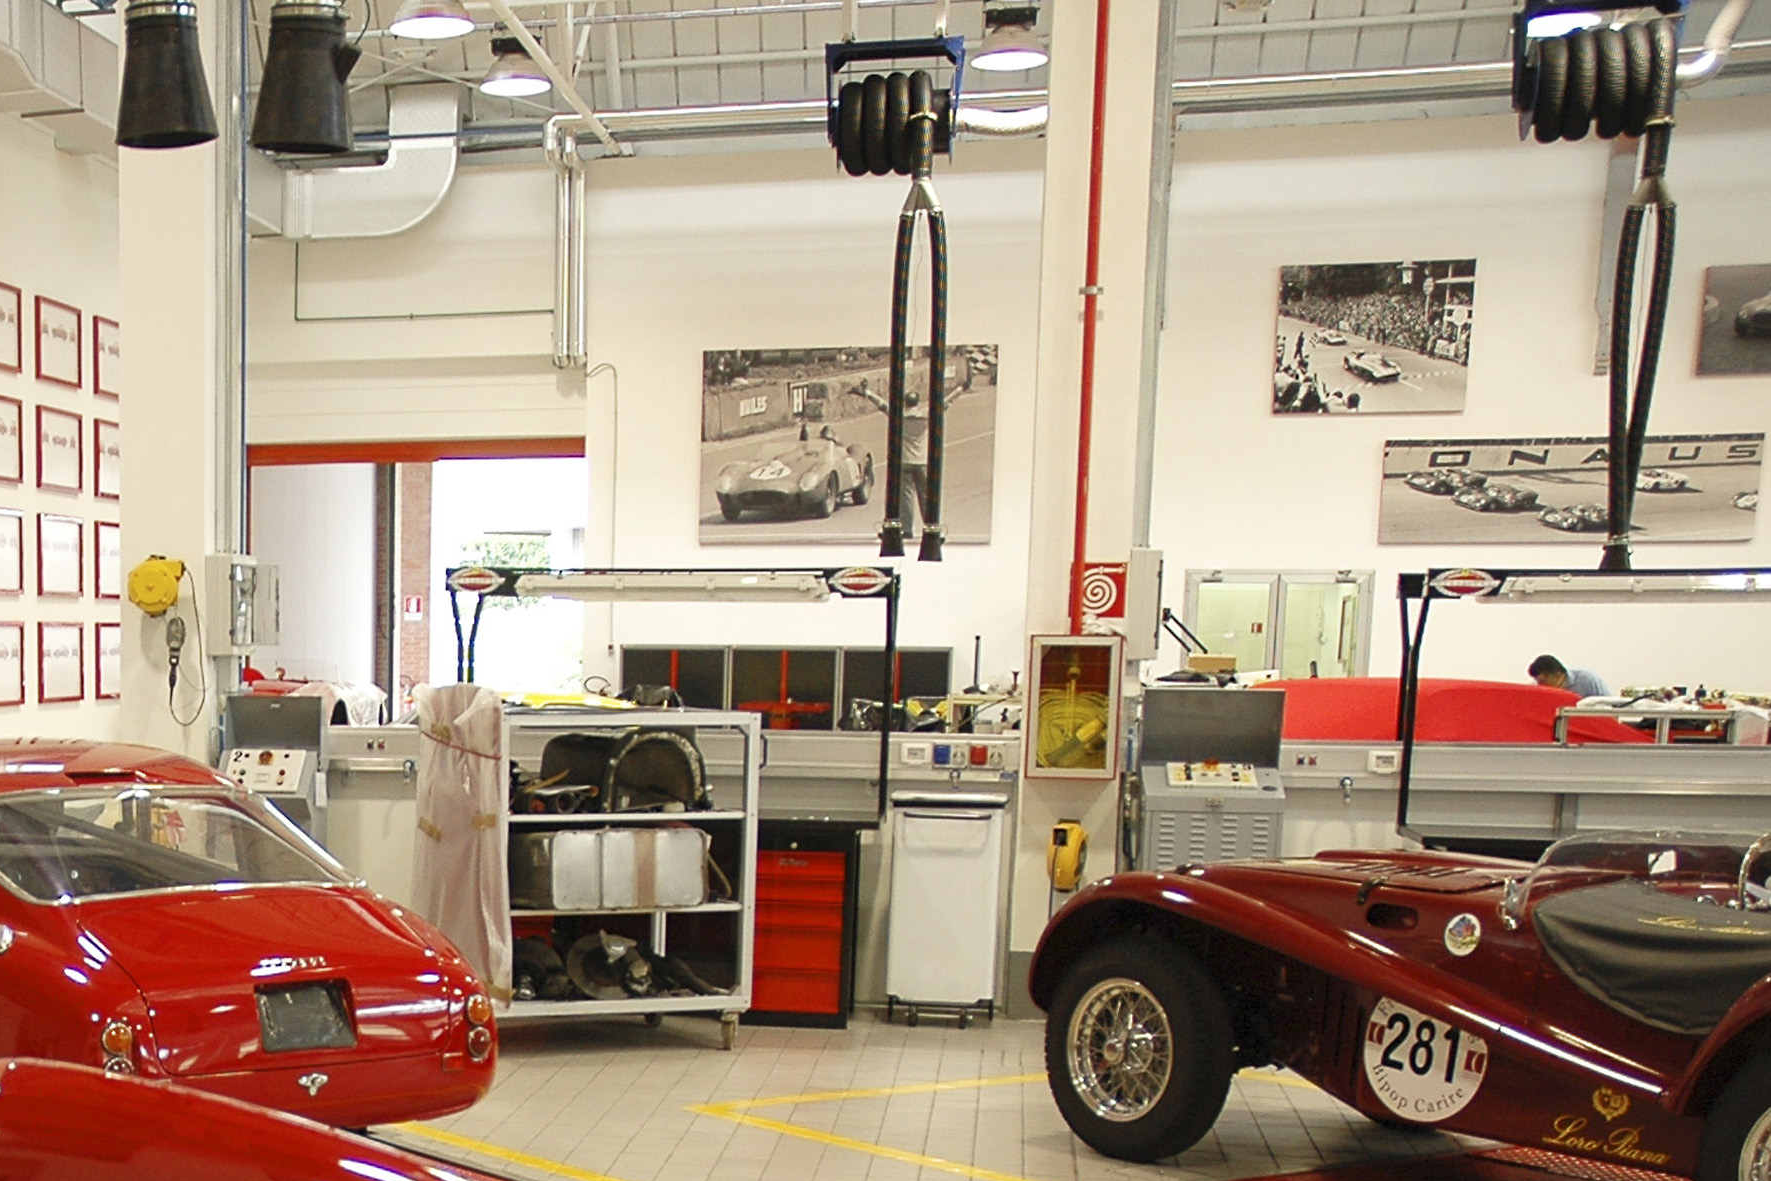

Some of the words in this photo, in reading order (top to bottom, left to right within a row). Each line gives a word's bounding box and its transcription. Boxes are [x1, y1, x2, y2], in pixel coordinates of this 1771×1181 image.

[233, 750, 243, 762] 2
[1381, 1012, 1462, 1083] 281
[1415, 1087, 1464, 1113] Carire
[1542, 1115, 1602, 1151] Loro
[1603, 1127, 1671, 1164] Piana
